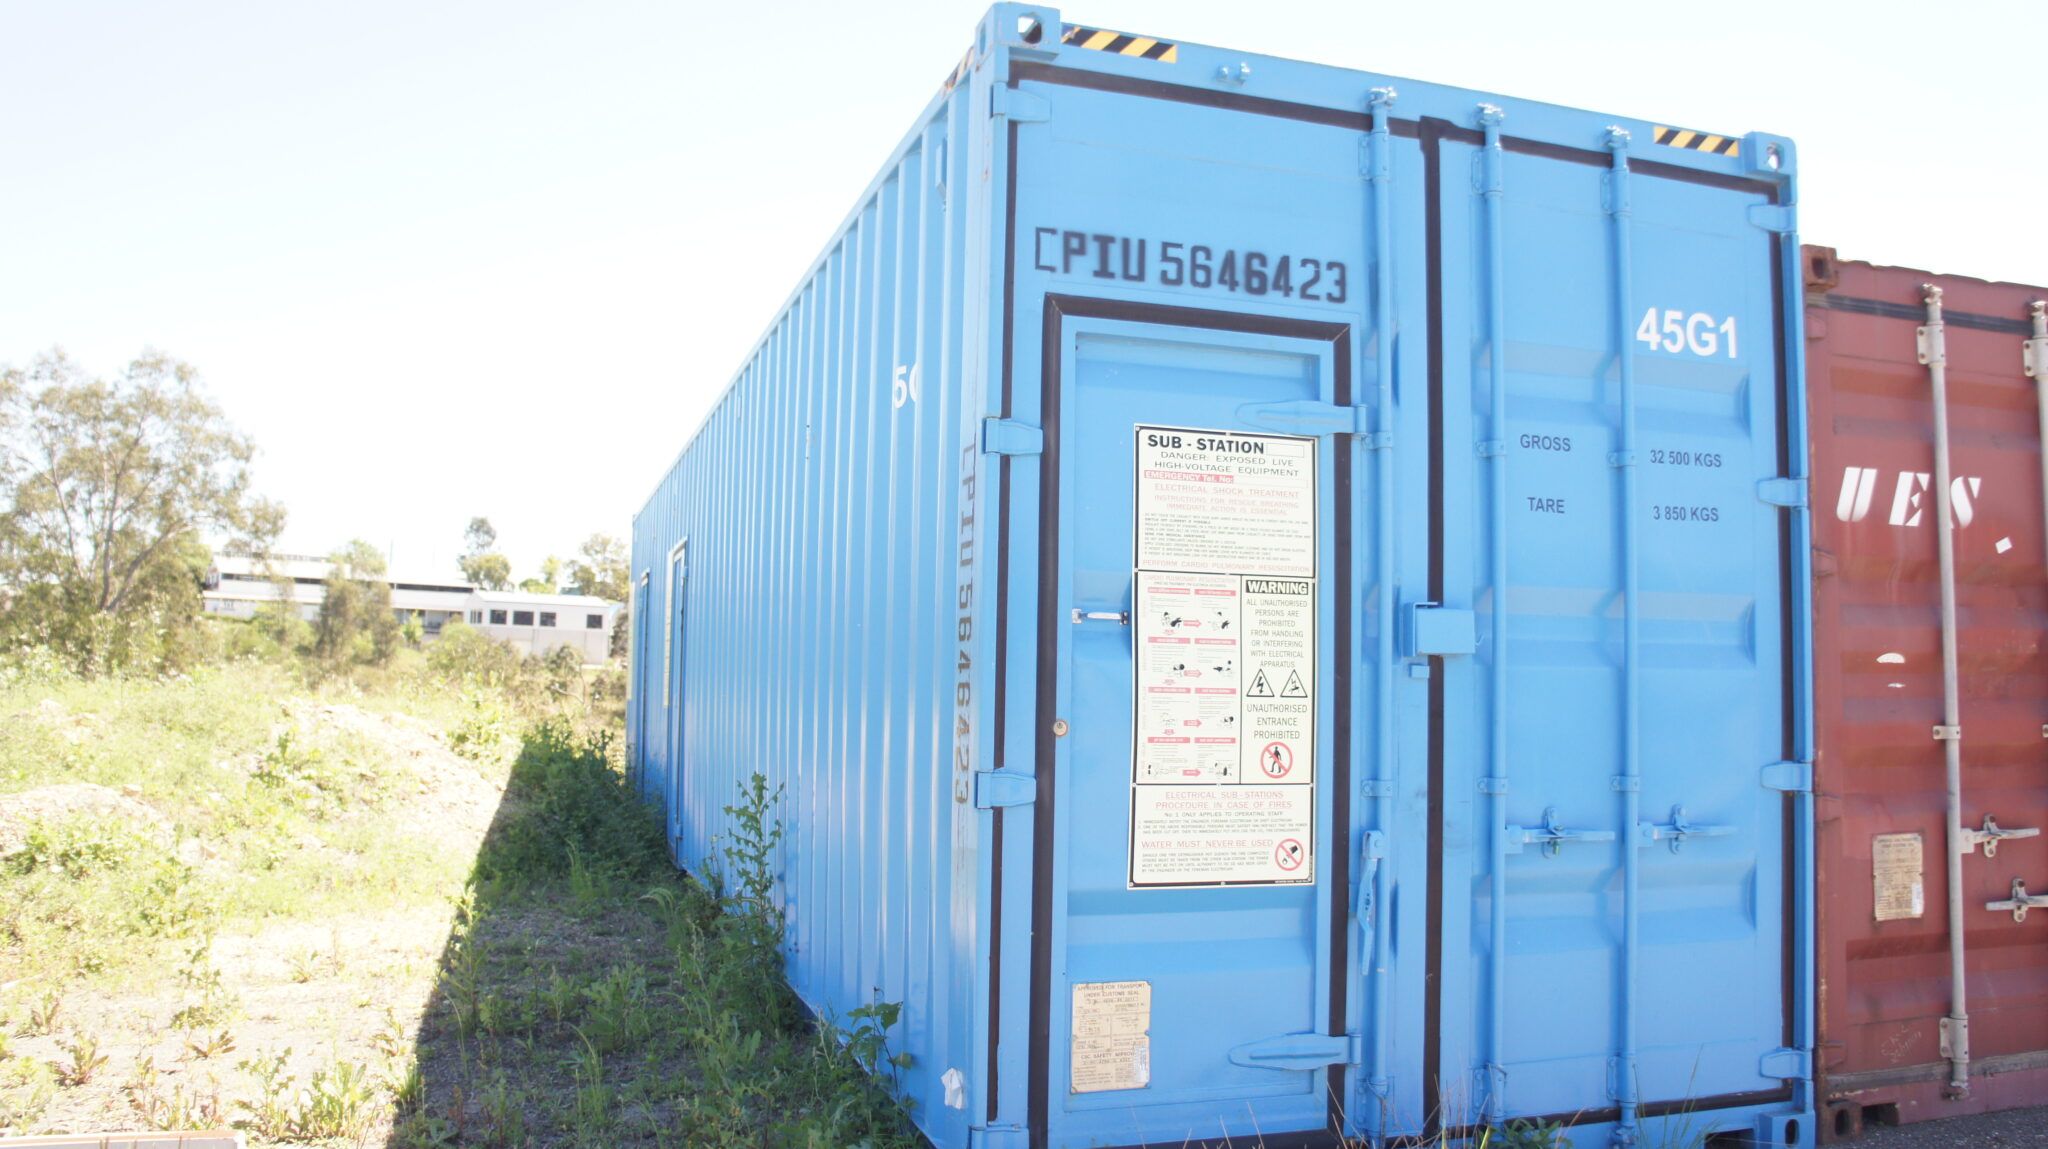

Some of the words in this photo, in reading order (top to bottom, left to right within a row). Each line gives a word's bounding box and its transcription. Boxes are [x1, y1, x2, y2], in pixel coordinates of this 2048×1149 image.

[1035, 226, 1147, 283] CPIU
[1160, 241, 1347, 304] 5646423
[1636, 307, 1737, 359] 45G1
[1147, 434, 1182, 449] SUB
[1196, 438, 1264, 454] STATION
[1520, 433, 1571, 452] GROSS
[1216, 455, 1266, 465] EXPOSED
[1272, 458, 1294, 467] LIVE
[1650, 449, 1665, 464] 32
[1669, 451, 1690, 466] 500
[1694, 453, 1722, 468] KGS
[1154, 461, 1232, 473] HIGH-VOLTAGE
[1238, 467, 1299, 477] EQUIPMENT
[1146, 471, 1199, 482] EMERGENCY
[1154, 483, 1207, 493] ELECTRICAL
[1213, 487, 1243, 495] SHOCK
[1250, 489, 1299, 498] TREATMENT
[1154, 495, 1207, 503] INSTRUCTIONS
[1528, 497, 1565, 514] TARE
[1653, 505, 1661, 520] 3
[1664, 506, 1686, 521] 850
[1690, 506, 1719, 522] KGS
[1247, 580, 1308, 595] WARNING
[1260, 599, 1308, 608] UNAUTHORISED
[1254, 609, 1285, 617] PERSONS
[1259, 619, 1296, 627] PROHIBITED
[1250, 629, 1269, 637] FROM
[1271, 630, 1304, 638] HANDLING
[1263, 640, 1303, 648] INTERFERING
[1269, 650, 1304, 658] ELECTRICAL
[954, 583, 973, 804] 5646423
[1246, 704, 1308, 713] UNAUTHORISED
[1257, 717, 1298, 726] ENTRANCE
[1253, 730, 1300, 739] PROHIBITED
[1165, 791, 1217, 800] ELECTRICAL
[1155, 801, 1209, 809] PROCEDURE
[1213, 801, 1223, 809] IN
[1227, 801, 1249, 809] CASE
[1253, 801, 1264, 809] OF
[1269, 801, 1292, 809] FIRES
[1141, 840, 1172, 849] WATER
[1176, 840, 1201, 848] MUST
[1205, 840, 1233, 848] NEVER
[1251, 839, 1274, 847] USED
